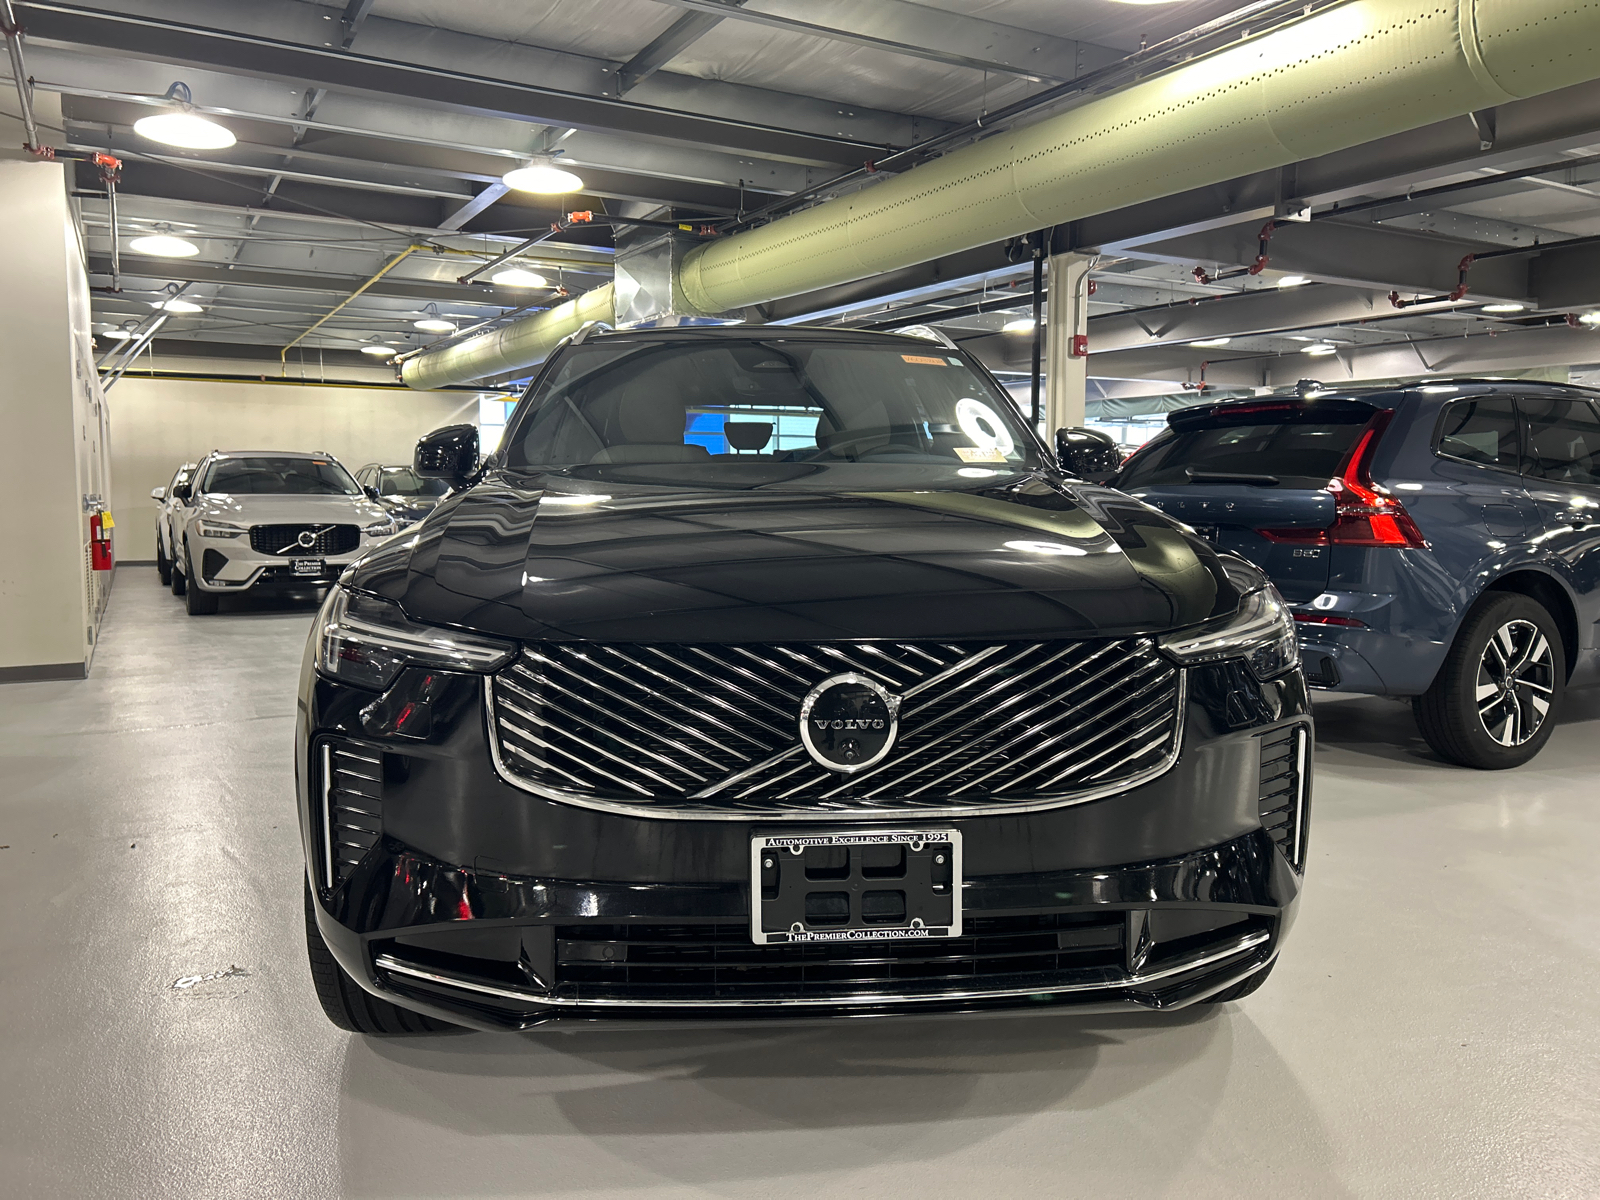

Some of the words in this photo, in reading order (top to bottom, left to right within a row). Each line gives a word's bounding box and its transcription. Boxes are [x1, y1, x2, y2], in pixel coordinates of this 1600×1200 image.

[1155, 500, 1236, 510] OLVO
[814, 719, 885, 730] VOLVO
[767, 837, 829, 846] AUTOMOTIVE
[831, 836, 889, 844] EXCELLENCE
[890, 833, 919, 843] SINCE
[921, 832, 948, 842] 1995
[786, 929, 930, 942] THEPREMIERCOLLECTION.COM
